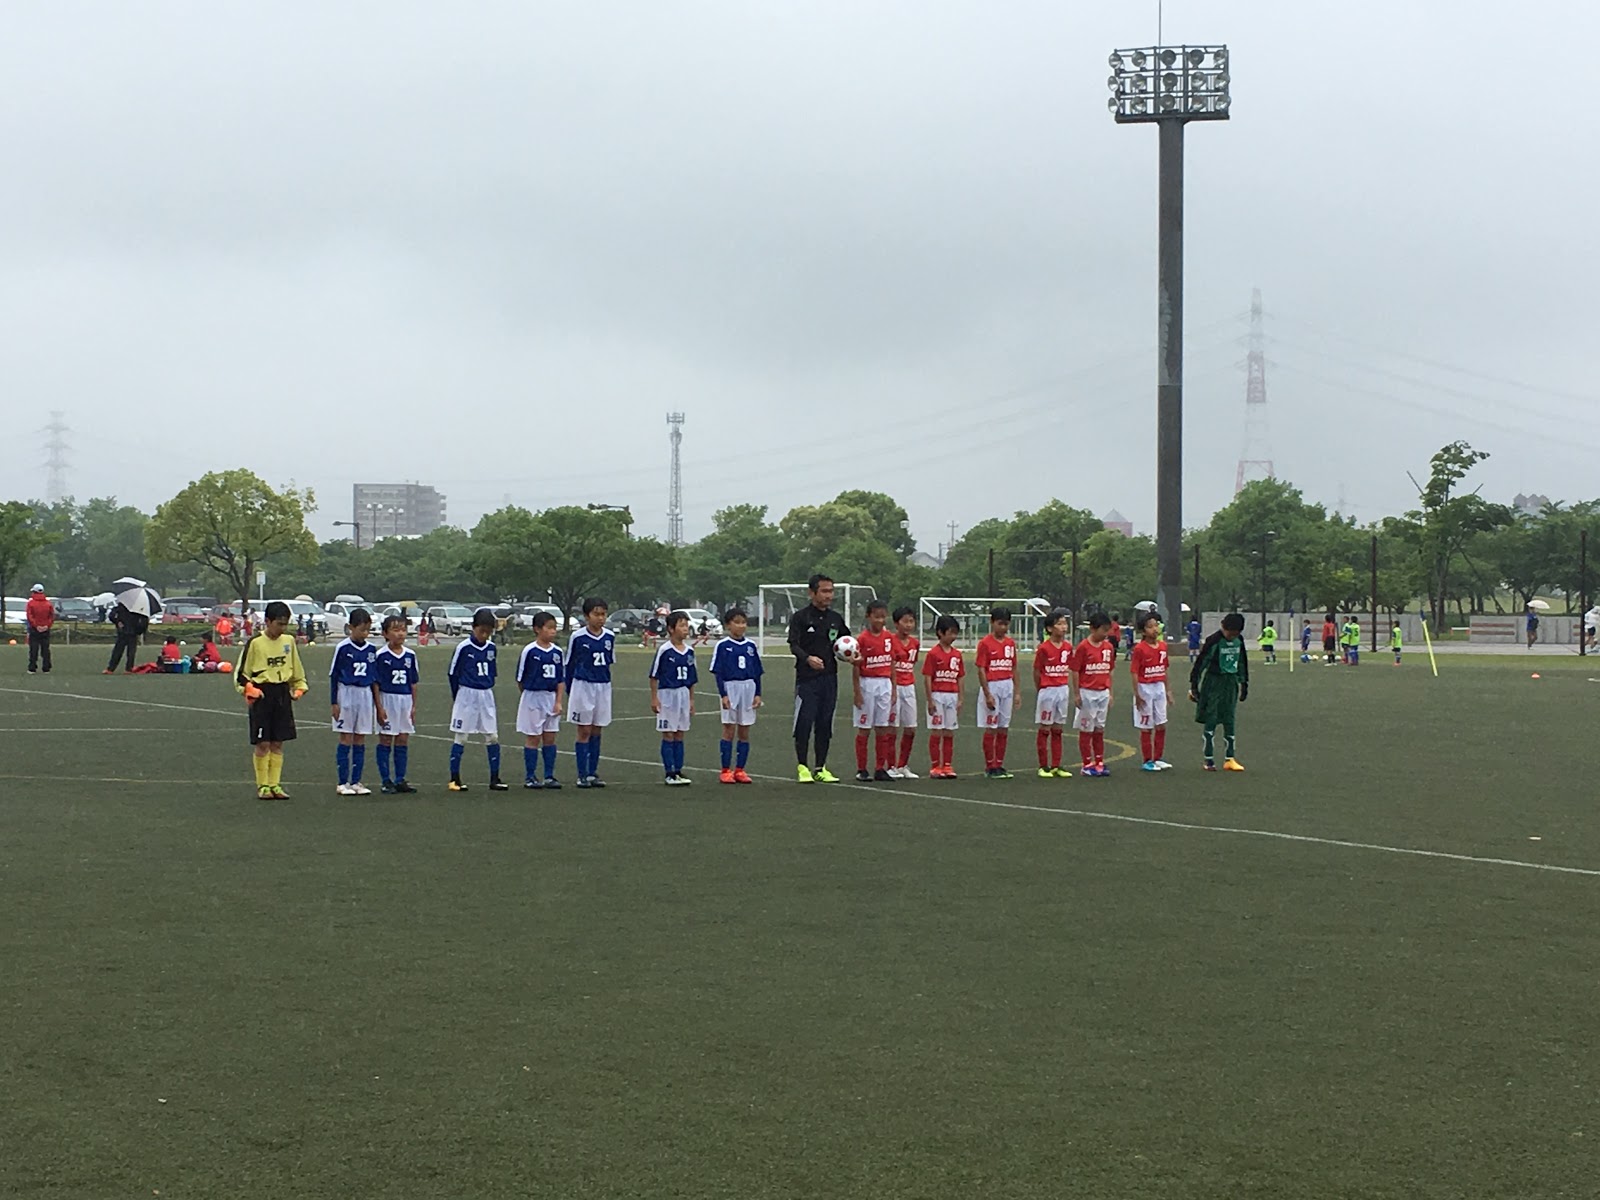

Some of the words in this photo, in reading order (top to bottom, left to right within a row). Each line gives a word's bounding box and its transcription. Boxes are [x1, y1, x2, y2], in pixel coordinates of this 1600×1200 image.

[884, 638, 892, 652] 5
[592, 652, 607, 665] 21
[738, 655, 746, 669] 8
[353, 662, 368, 676] 22
[391, 669, 407, 684] 25
[860, 714, 867, 725] 5
[257, 727, 264, 739] 1
